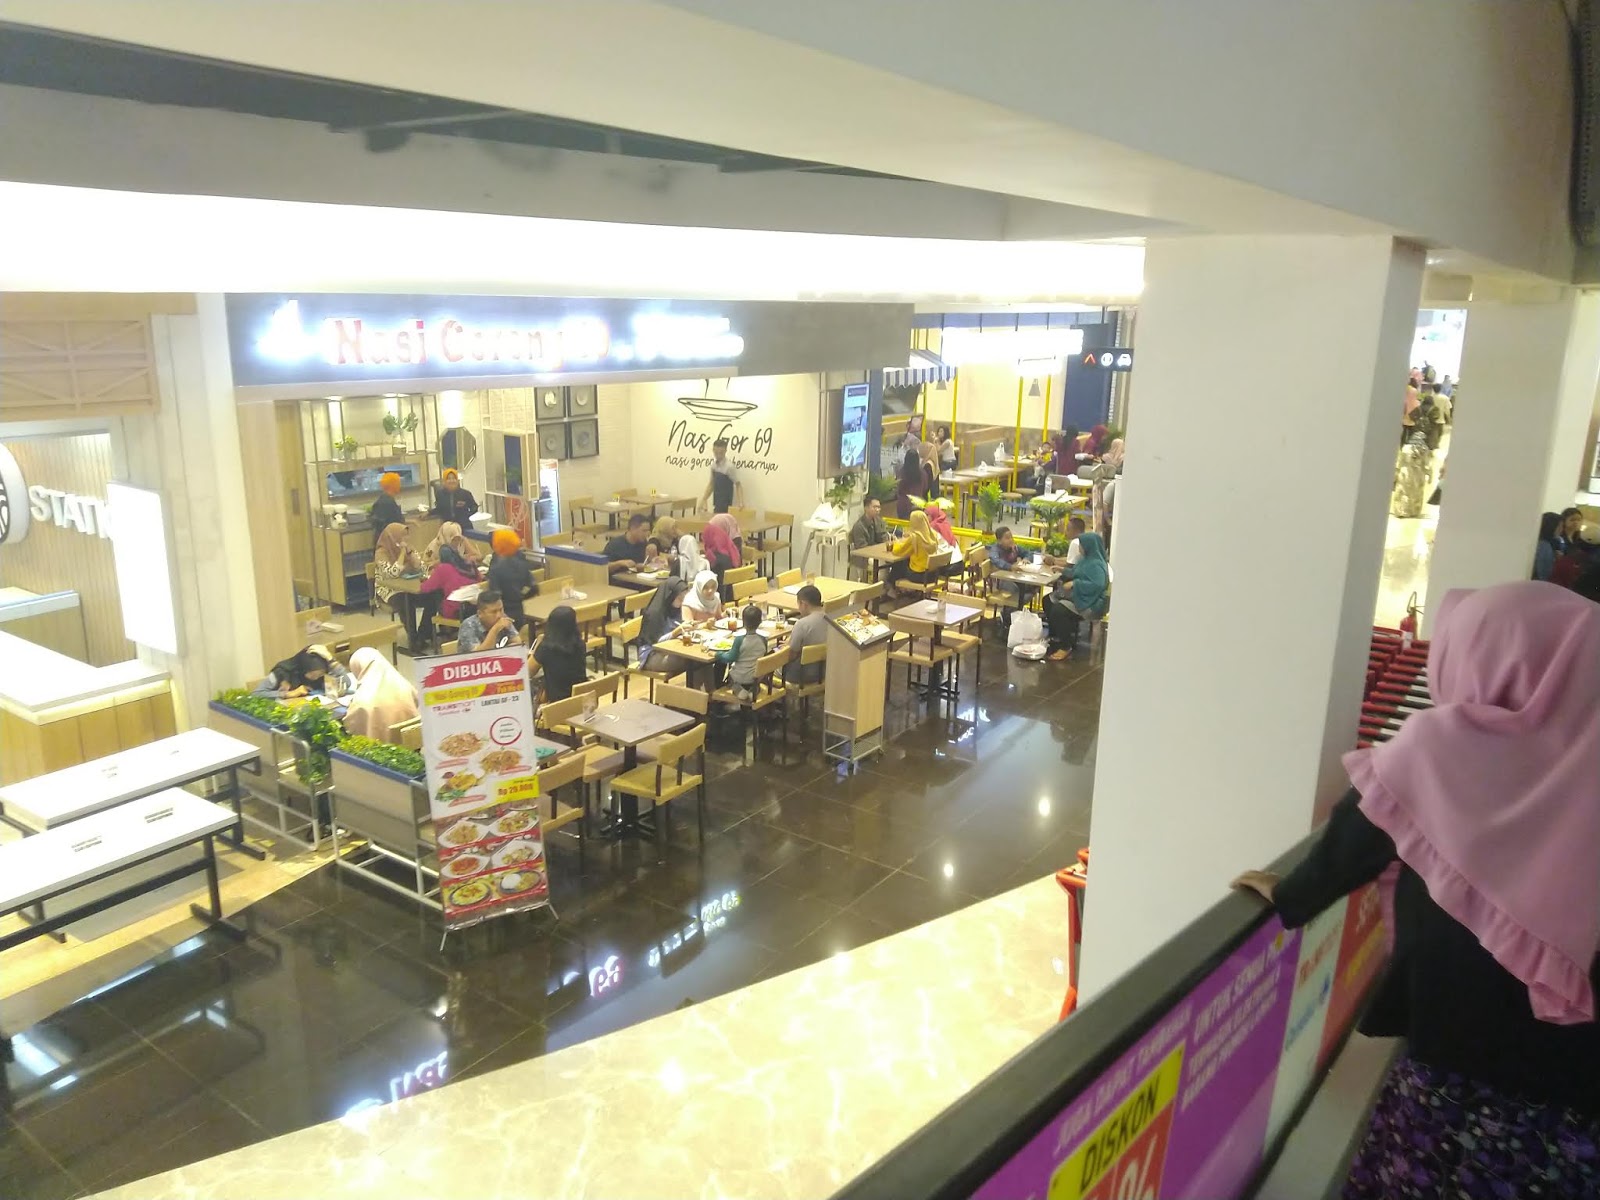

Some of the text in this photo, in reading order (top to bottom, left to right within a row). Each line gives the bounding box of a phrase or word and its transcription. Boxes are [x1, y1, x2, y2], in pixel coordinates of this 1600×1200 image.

[668, 419, 711, 454] Nas
[754, 427, 773, 457] 69
[665, 455, 689, 468] nasi
[690, 458, 716, 470] goren
[443, 660, 503, 681] DIBUKA
[1080, 1073, 1160, 1195] DISKON
